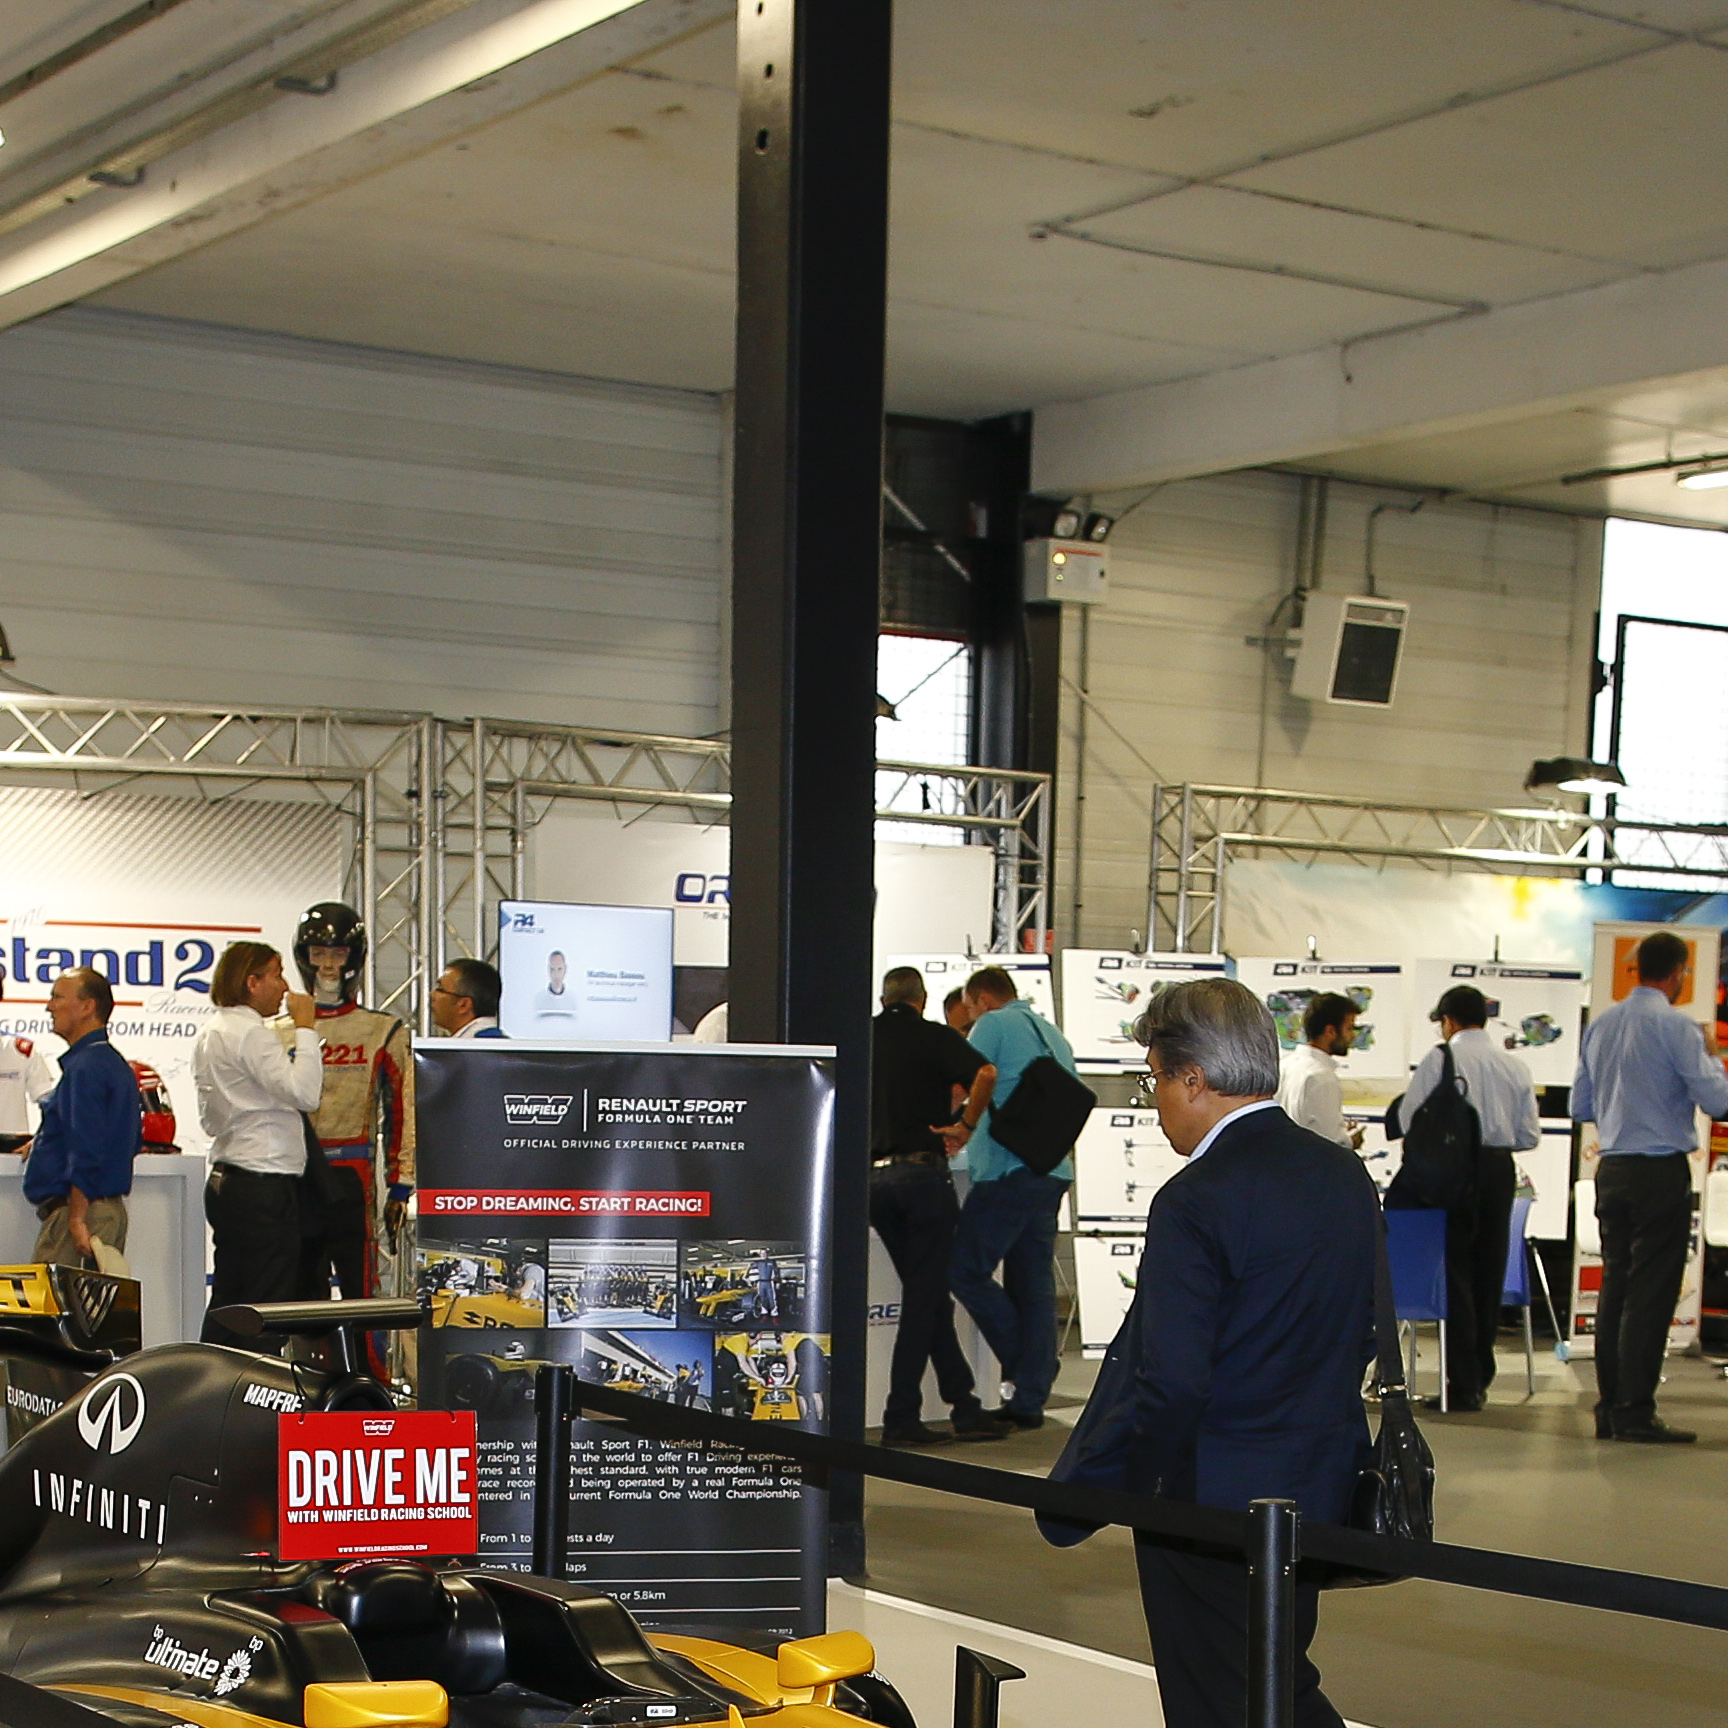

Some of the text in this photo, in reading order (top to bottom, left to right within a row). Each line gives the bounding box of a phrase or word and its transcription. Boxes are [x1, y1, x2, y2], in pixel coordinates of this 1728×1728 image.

[148, 1021, 197, 1038] HEAD
[505, 1098, 747, 1116] WINFIELD RENAULT SPORT
[597, 1113, 734, 1125] FORMULA ONE TEAM
[503, 1138, 746, 1151] OFFICIAL DRIVING EXPERIENCE PARTNER
[434, 1196, 703, 1212] STOP DREAMING, START RACING!
[601, 1440, 630, 1452] Sport
[660, 1440, 703, 1450] Winfield
[487, 1453, 520, 1464] racing
[582, 1453, 600, 1462] the
[605, 1453, 635, 1462] world
[641, 1453, 653, 1462] to
[657, 1453, 682, 1462] offer
[687, 1453, 699, 1462] F1
[706, 1453, 742, 1464] Driving
[510, 1465, 521, 1475] at
[655, 1465, 679, 1474] with
[686, 1465, 708, 1474] true
[714, 1464, 755, 1474] modern
[762, 1464, 772, 1473] F1
[781, 1464, 802, 1473] cars
[288, 1447, 471, 1508] DRIVE ME
[581, 1477, 611, 1489] being
[617, 1477, 665, 1489] operated
[672, 1477, 685, 1489] by
[691, 1479, 698, 1487] a
[705, 1477, 725, 1487] real
[731, 1476, 773, 1487] Formula
[779, 1476, 802, 1486] One
[478, 1488, 802, 1501] ntered in urrent Formula One World Championship.
[33, 1468, 166, 1545] INFINITI
[287, 1506, 473, 1524] WITH WINFIELD RACING SCHOOL
[480, 1532, 508, 1544] From
[511, 1532, 517, 1544] 1
[520, 1533, 532, 1544] to
[586, 1534, 593, 1543] a
[594, 1532, 615, 1545] day
[520, 1563, 532, 1573] to
[565, 1562, 587, 1574] laps
[619, 1591, 632, 1600] or
[633, 1589, 666, 1600] 5.8km
[153, 1624, 164, 1641] bp
[248, 1635, 265, 1652] bp
[144, 1636, 221, 1681] ultimate
